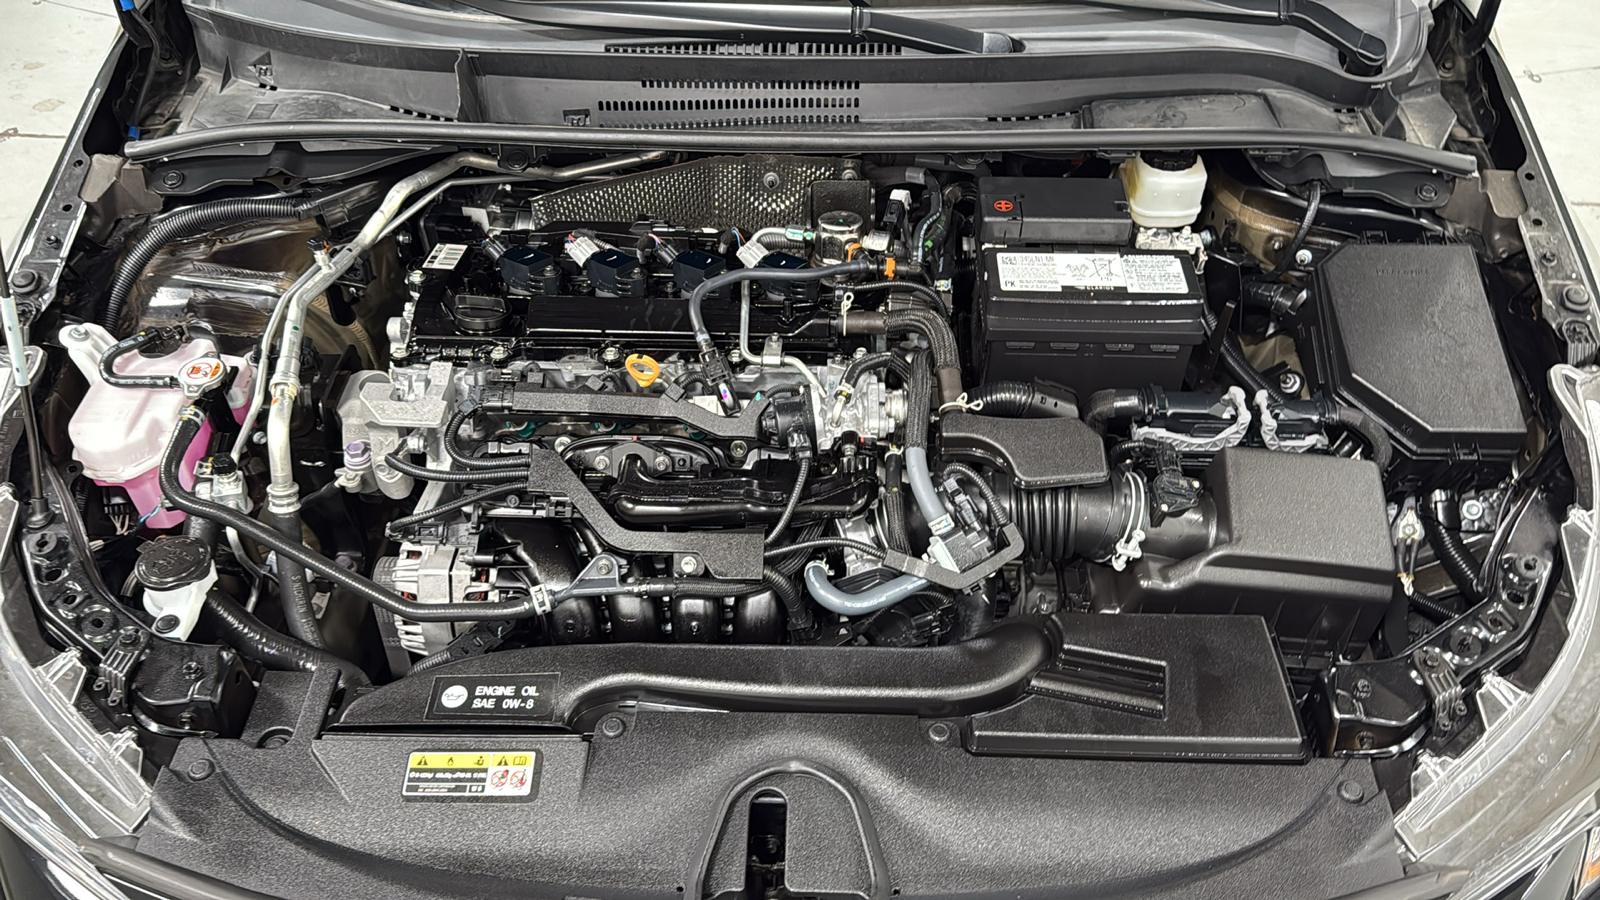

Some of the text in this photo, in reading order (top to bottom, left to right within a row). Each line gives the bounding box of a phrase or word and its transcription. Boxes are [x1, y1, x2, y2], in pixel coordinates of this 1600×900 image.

[475, 685, 540, 696] ENGINE OIL
[471, 698, 534, 709] SAE 0W-8
